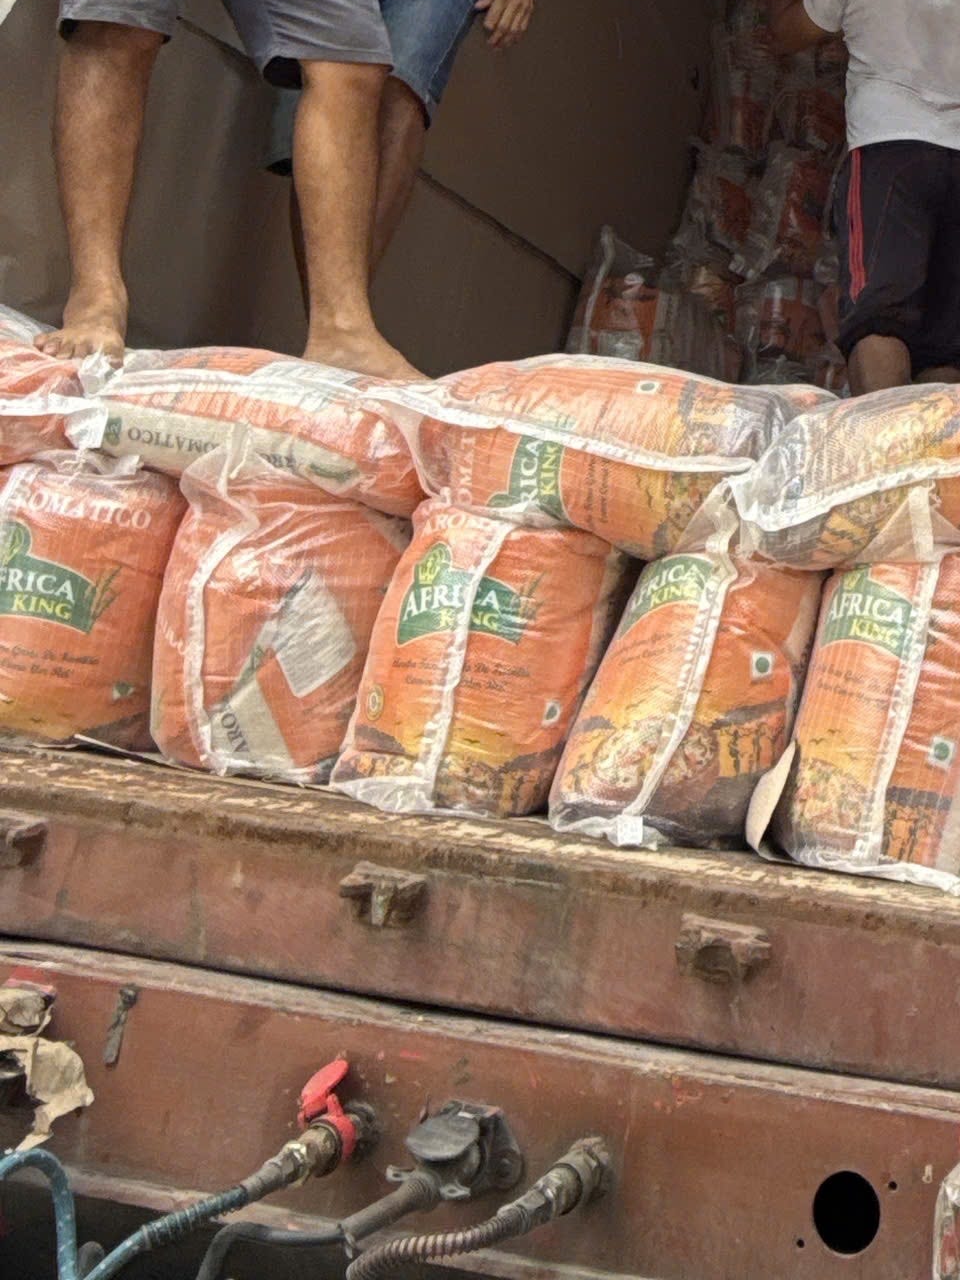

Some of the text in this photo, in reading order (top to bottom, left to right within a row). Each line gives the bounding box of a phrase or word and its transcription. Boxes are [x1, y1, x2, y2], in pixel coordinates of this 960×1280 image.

[518, 439, 544, 506] RICA
[10, 591, 74, 620] KING
[402, 584, 500, 622] AFRIA
[439, 607, 500, 630] KNG
[830, 591, 905, 624] AFRICA
